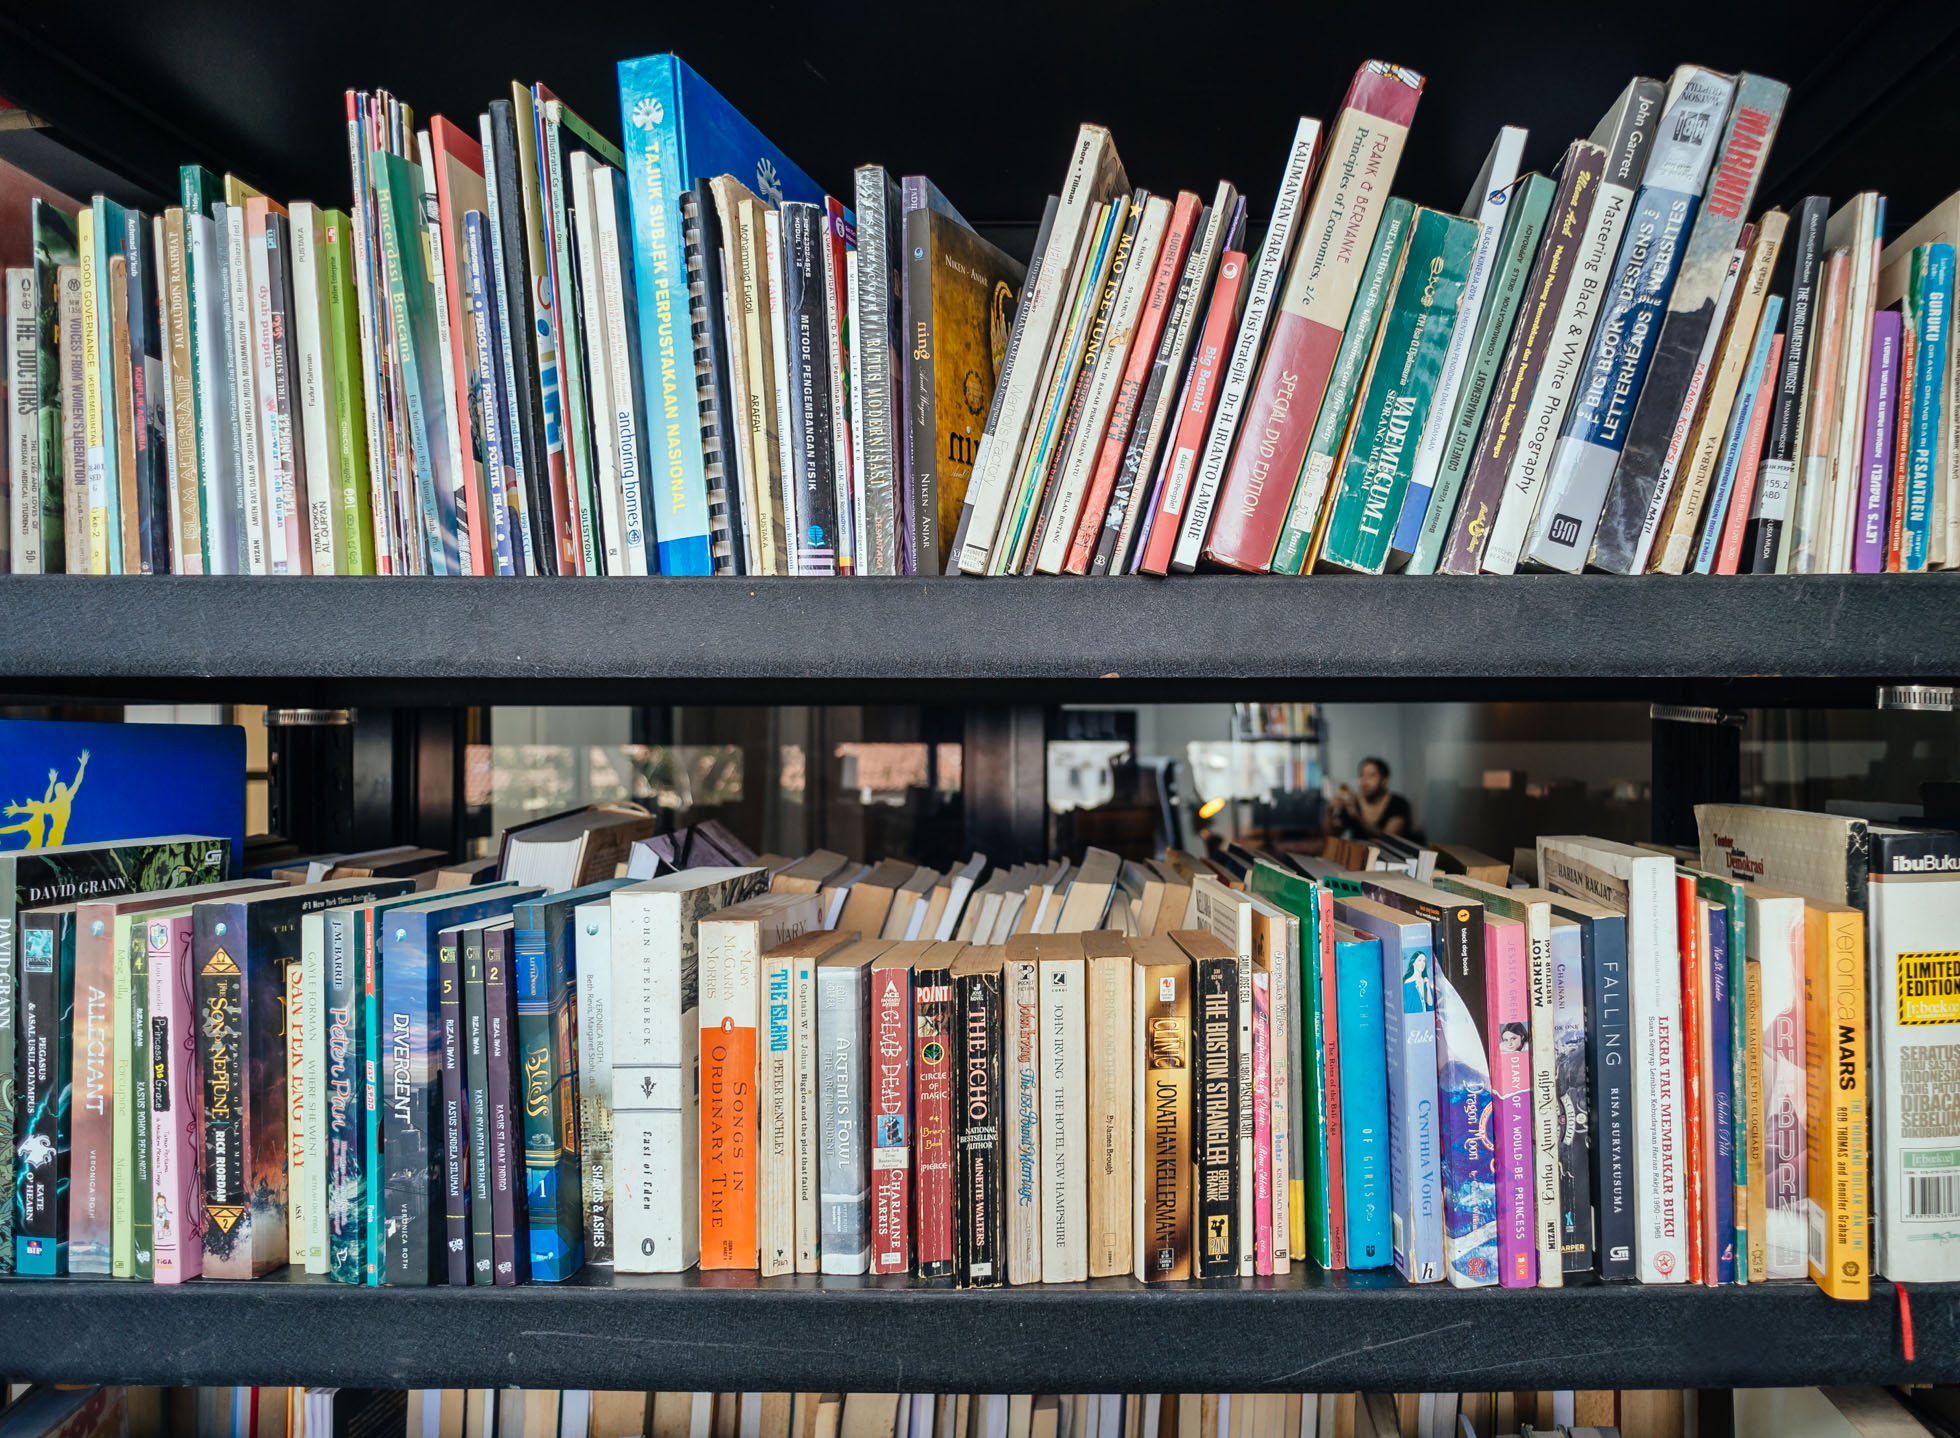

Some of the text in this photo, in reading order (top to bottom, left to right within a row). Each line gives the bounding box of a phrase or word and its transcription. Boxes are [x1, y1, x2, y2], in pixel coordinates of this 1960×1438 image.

[1066, 140, 1092, 205] Shore Tillman
[1617, 96, 1654, 179] John Garrett
[1708, 107, 1772, 220] MARINIR
[129, 219, 139, 277] Achmad Ya'kub
[379, 189, 412, 362] Mencerdasi Bencana
[1728, 255, 1741, 278] KPK
[83, 256, 96, 367] GOOD GOVERNANCE
[260, 286, 273, 368] dyah puspita
[645, 142, 686, 514] TAJUK SUBJEK PERPUSTAKAAN NASIONAL
[1084, 231, 1134, 364] MAO TSE-TUNG
[1599, 199, 1688, 441] LETTERHEADS WEBSITES
[1788, 301, 1808, 360] CONGLOMERATE
[1797, 286, 1810, 301] THE
[1187, 141, 1310, 540] KALIMANTAN UTARA: Kini & Visi Stratejik Dr. H. IRIANTO LAMBRIE
[1191, 345, 1216, 413] Big Basuki
[1521, 195, 1624, 495] Mastering Black & White Photography
[1784, 361, 1800, 395] MINDSET
[752, 395, 761, 432] ARAFAH
[801, 315, 817, 491] METODE PENGEMBANGAN FISIK
[1360, 389, 1397, 490] SEORANG MUSLIM
[1448, 370, 1489, 471] CONFLICT MANAGEMENT
[1783, 400, 1793, 423] TANAM
[618, 412, 639, 527] anchoring homes
[1240, 370, 1298, 517] SPECIAL DVD EDITION
[1685, 435, 1717, 517] SITTI NURBAYA
[582, 508, 592, 562] SULISTYONO
[30, 877, 127, 902] DAVID GRANN
[643, 908, 651, 1045] JOHN STEINBECK
[707, 946, 718, 998] MORRIS
[1461, 929, 1471, 976] black dog books
[1532, 939, 1544, 1008] MARKESOT
[771, 969, 787, 1051] THE ISLAND
[918, 987, 949, 1003] POINT
[1836, 923, 1862, 1090] veronica MARS
[86, 986, 105, 1115] ALLEGIANT
[330, 1007, 350, 1076] Peter
[394, 1014, 410, 1123] DIVERGENT
[446, 1019, 456, 1069] RIZAL IWAN
[881, 1010, 901, 1113] CLUB DEAD
[969, 1007, 987, 1120] THE ECHO
[1153, 1019, 1179, 1069] CLINIC
[1207, 992, 1228, 1165] THE BOSTON STRANGLER
[1511, 1057, 1521, 1088] DIARY
[330, 1080, 350, 1131] Pan
[774, 1058, 784, 1155] PETER BENCHLEY
[1055, 1005, 1066, 1248] JOHN IRVING THE HOTEL NEW HAMPSHIRE
[1157, 1081, 1177, 1155] JONATHAN
[1513, 1096, 1521, 1107] OF
[1658, 1016, 1675, 1238] LEKRA TAK MEMBAKAR BUKU
[214, 1132, 224, 1202] RICK RIORDAN
[593, 1165, 603, 1202] SHARDS
[644, 1131, 652, 1210] East of Eden
[1104, 1115, 1114, 1175] By James Brough
[1419, 1100, 1436, 1219] CYNTHIA VOIGT
[1514, 1127, 1524, 1179] WOULD-BE
[1611, 1088, 1622, 1214] RINA SURYAKUSUMA
[1837, 1106, 1849, 1244] ROB THOMAS and Jennifer Graham
[879, 1185, 892, 1235] HARRIS
[891, 1170, 903, 1248] CHARLAINE
[975, 1158, 985, 1246] MINETTE WALTERS
[1157, 1161, 1177, 1241] KELLERMAN
[1207, 1171, 1218, 1200] FRANK
[1217, 1170, 1228, 1200] GEROLD
[1515, 1187, 1525, 1239] PRINCESS
[594, 1215, 604, 1246] ASHES
[1547, 1222, 1556, 1250] MIZAN
